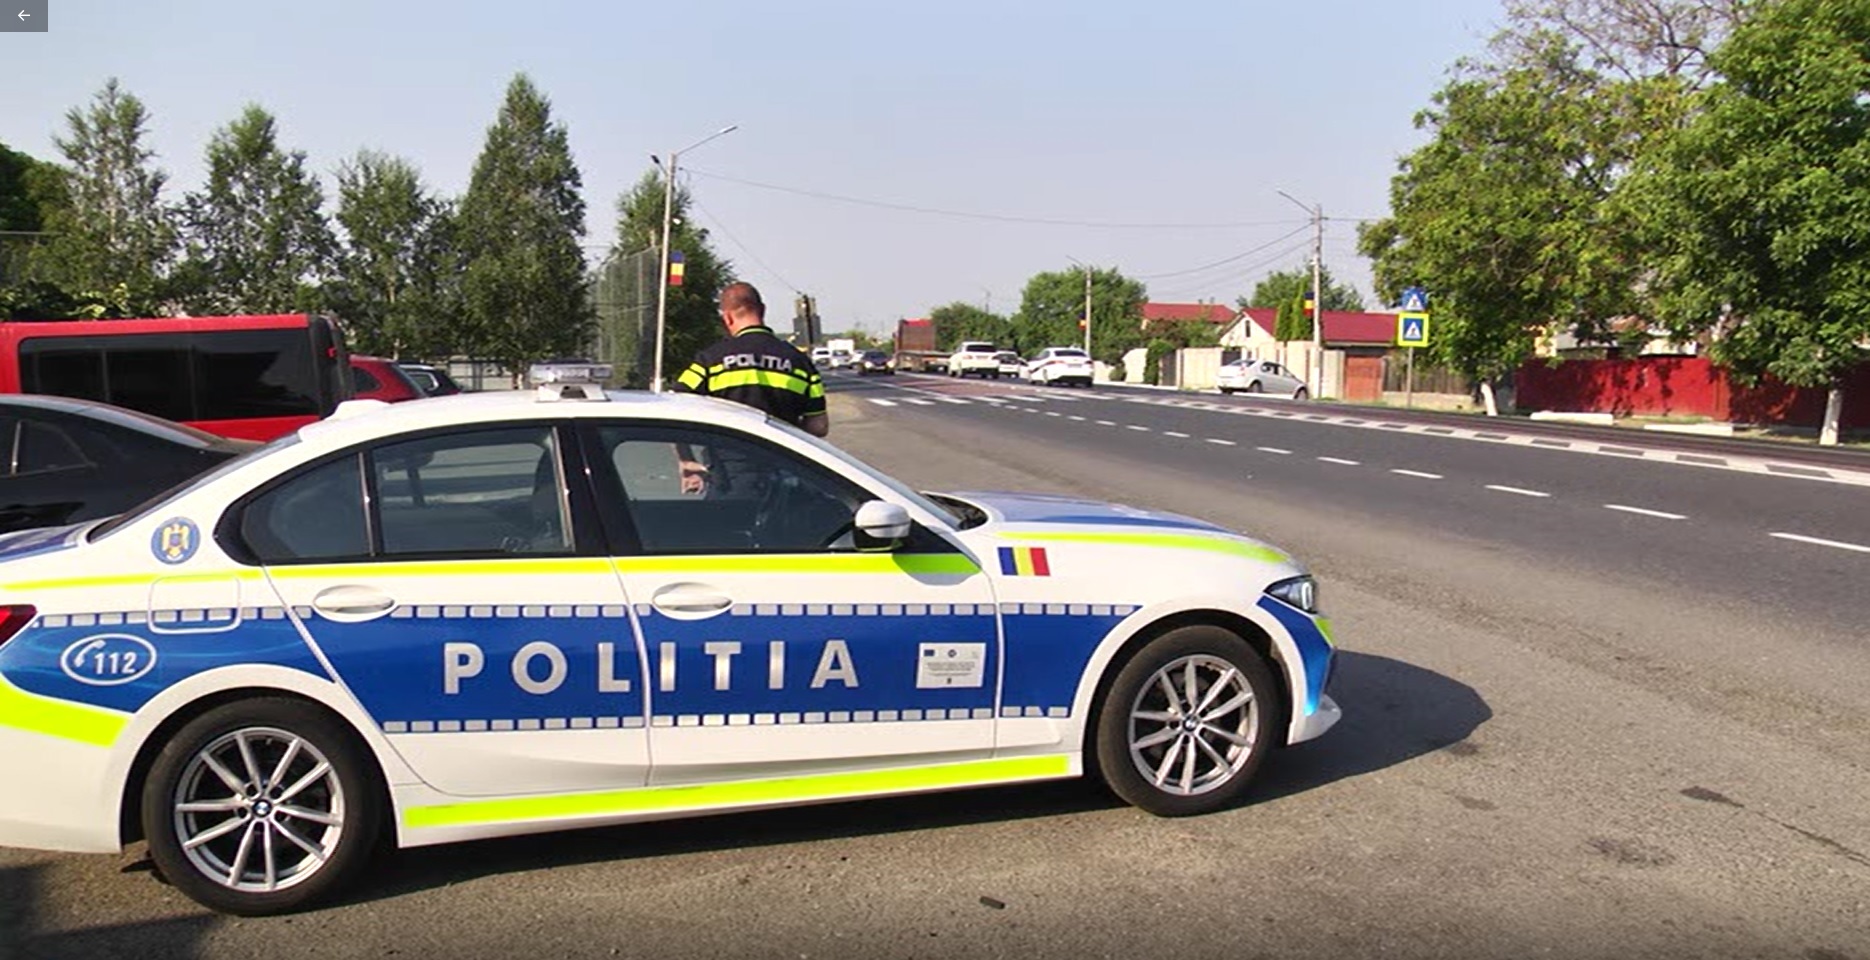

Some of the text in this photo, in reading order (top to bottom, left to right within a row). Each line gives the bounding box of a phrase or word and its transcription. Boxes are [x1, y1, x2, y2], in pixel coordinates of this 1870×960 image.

[723, 353, 793, 373] POLITIA
[94, 651, 137, 675] 112
[443, 640, 859, 695] POLITIA
